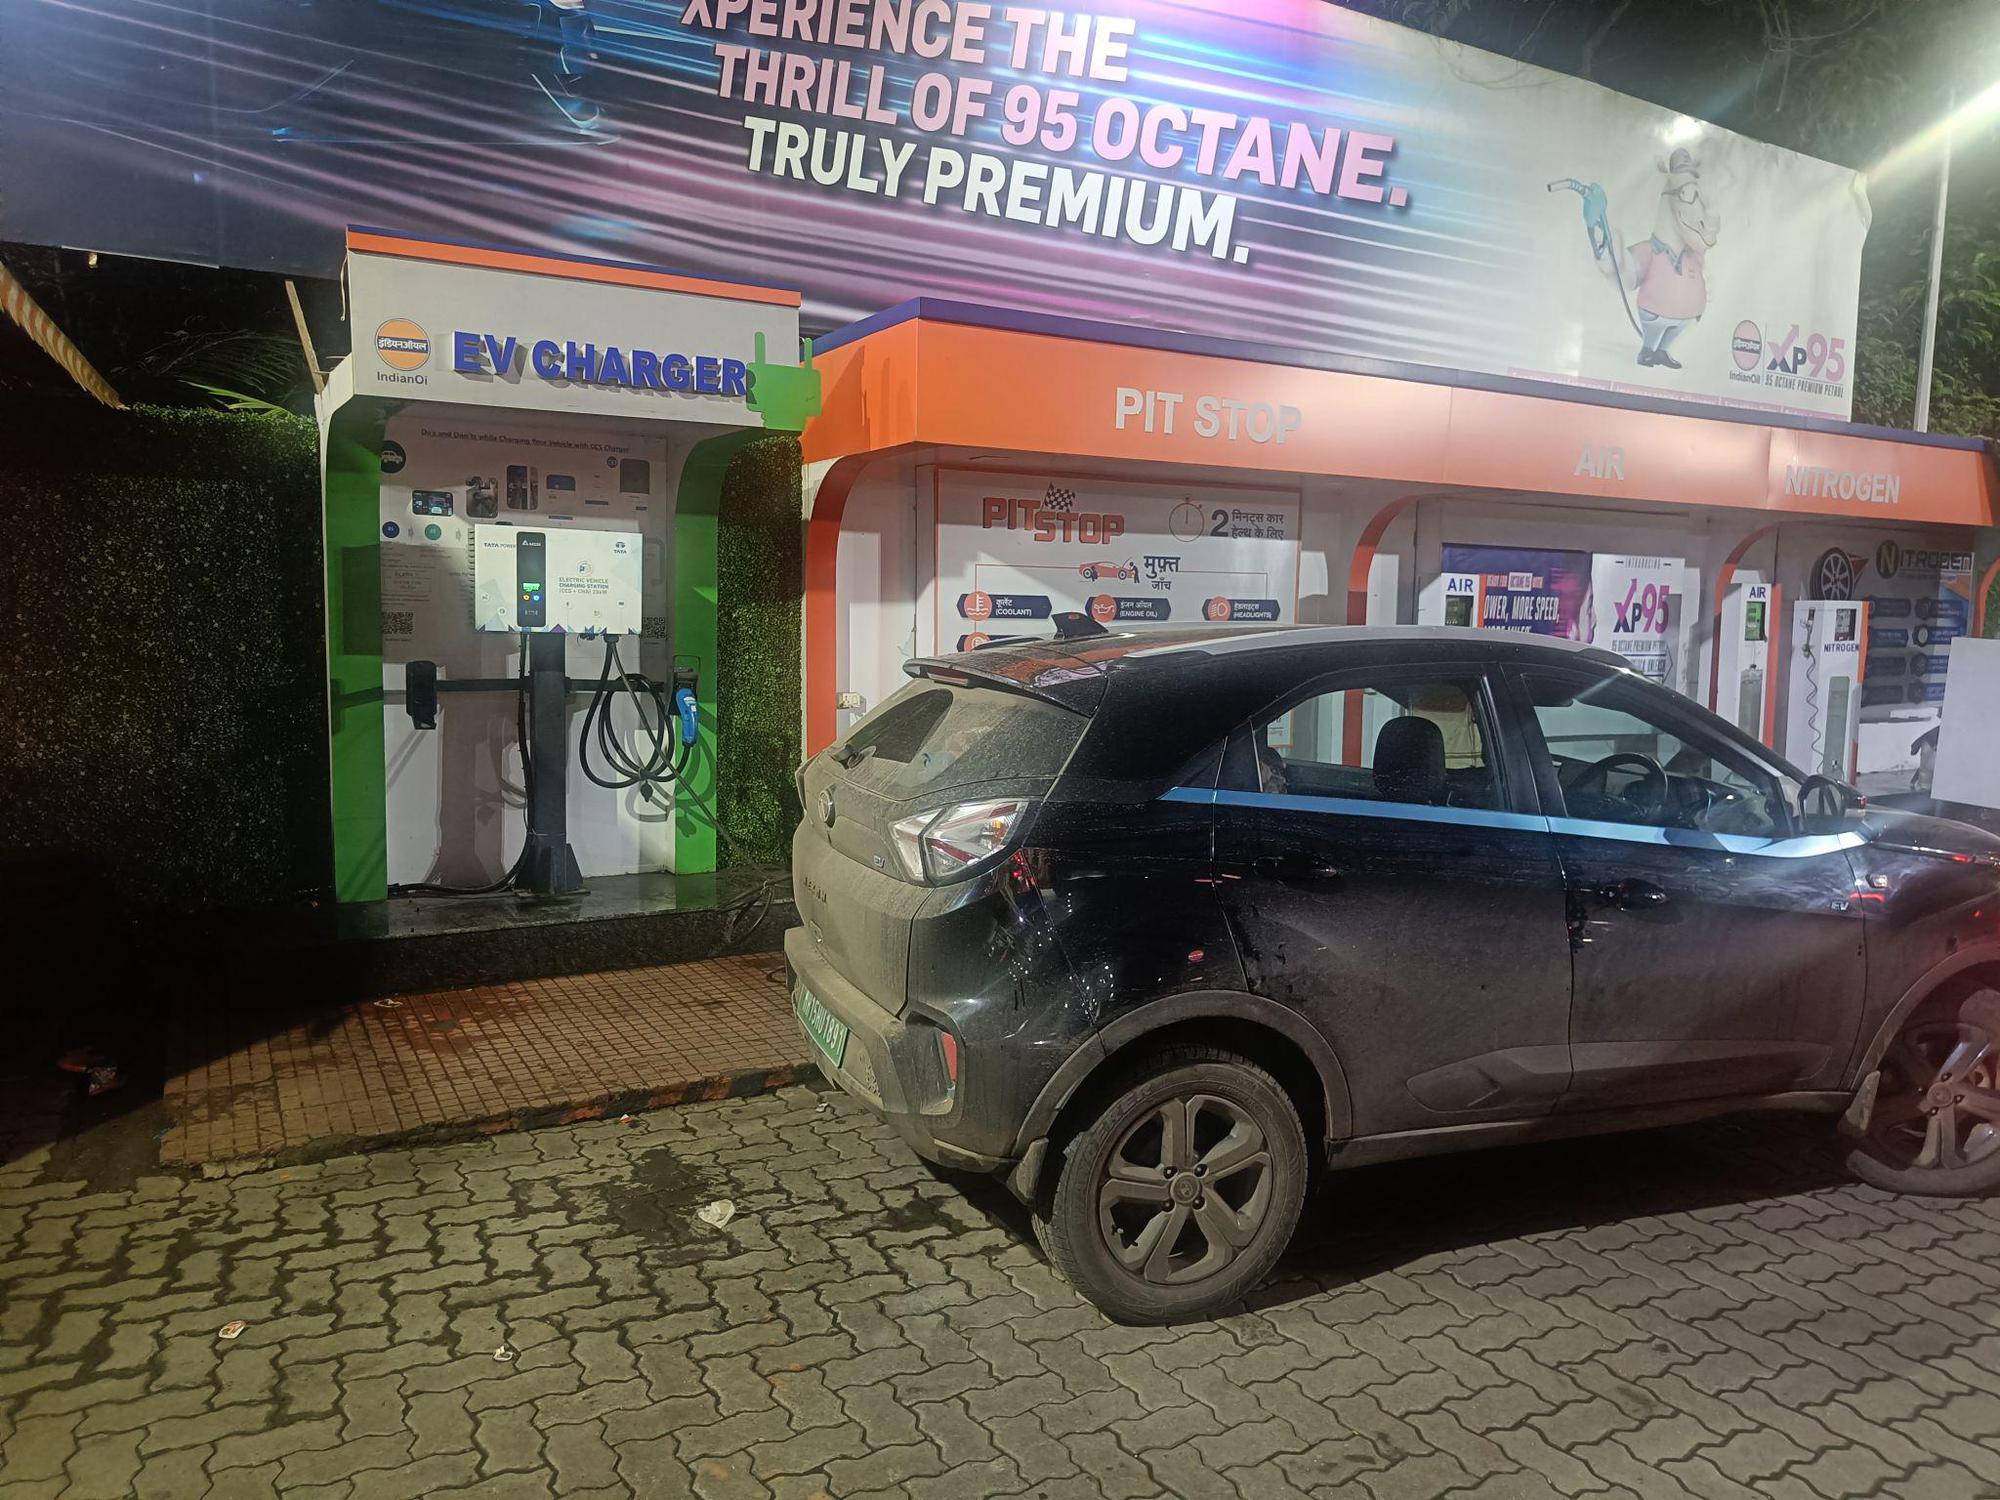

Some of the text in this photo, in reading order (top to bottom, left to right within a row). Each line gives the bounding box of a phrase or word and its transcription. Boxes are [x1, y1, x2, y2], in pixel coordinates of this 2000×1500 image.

[1005, 7, 1136, 82] THE
[715, 43, 1408, 207] THRILL OF 95 OCTANE.
[743, 116, 1250, 264] TRULY PREMIUM.
[453, 331, 748, 397] EV CHARGER
[1766, 324, 1845, 382] XP95
[377, 371, 429, 385] IndianOi
[1797, 379, 1823, 395] PREMIUM
[1115, 387, 1303, 444] PIT STOP
[1573, 443, 1625, 481] AIR
[1785, 464, 1901, 505] NITROGEN
[982, 496, 1042, 531] PIT
[1034, 510, 1125, 545] STOP
[1210, 509, 1229, 538] 2
[1266, 513, 1285, 524] कार
[1254, 525, 1264, 539] के
[1266, 525, 1285, 541] लिए
[1447, 577, 1474, 593] AIR
[1749, 586, 1766, 599] AIR
[1119, 610, 1145, 618] (ENGINE
[1483, 594, 1560, 623] OWER, MORE SPEED,
[1613, 578, 1670, 634] XP95
[1823, 642, 1860, 653] NITROGEN
[873, 855, 885, 868] EV
